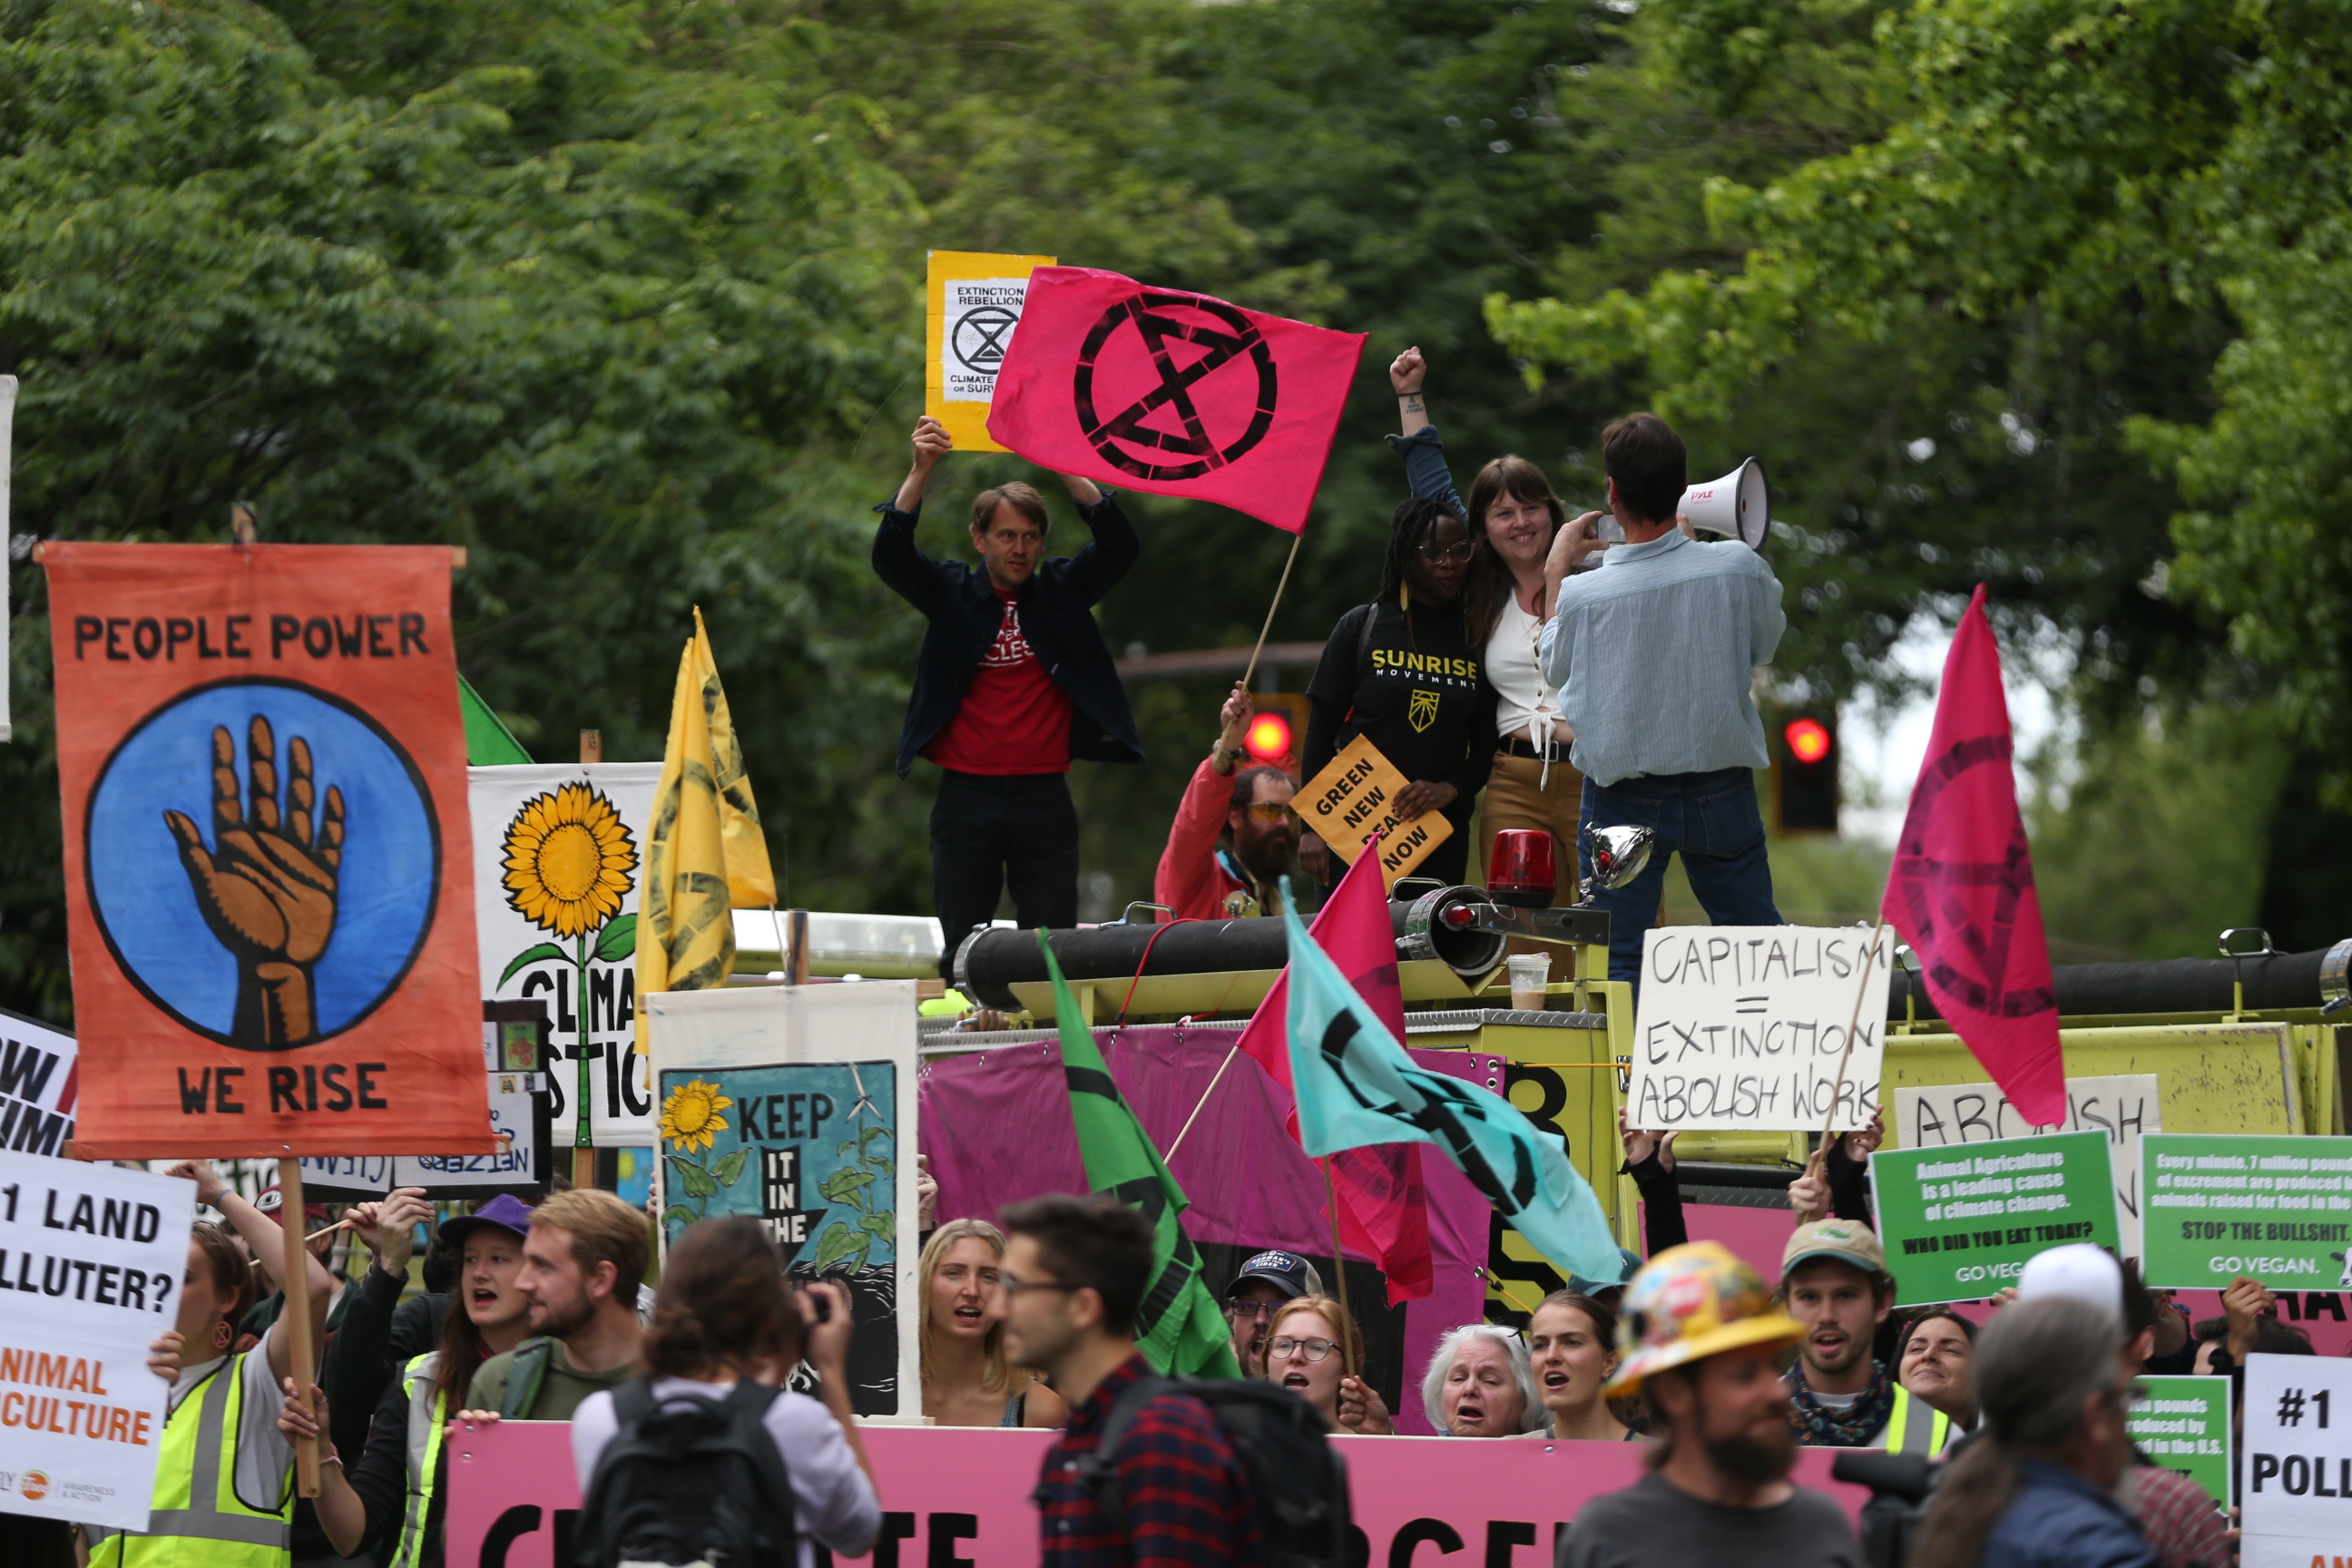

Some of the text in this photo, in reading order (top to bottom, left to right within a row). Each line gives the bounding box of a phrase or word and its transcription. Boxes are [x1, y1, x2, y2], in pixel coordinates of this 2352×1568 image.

[957, 287, 1024, 296] EXTINCTION
[958, 297, 1024, 306] REBELLION
[950, 375, 994, 384] CLIMATE
[1690, 490, 1714, 500] PYLE
[74, 612, 429, 662] PEOPLE POWER
[1371, 649, 1477, 680] SUNRISE
[1376, 669, 1475, 690] MOVEMENT
[1316, 758, 1375, 816] GREEN
[1343, 785, 1386, 829] NEW
[1361, 808, 1402, 848] DEA
[1382, 825, 1428, 872] NOW
[1652, 935, 1886, 986] CAPITALISM
[522, 968, 635, 1033] CLIMA
[1648, 1018, 1876, 1064] EXTINCTION
[0, 1037, 60, 1103] W
[177, 1063, 388, 1115] WE RISE
[1639, 1062, 1879, 1126] ABOLISH WORK
[738, 1093, 834, 1143] KEEP
[1916, 1092, 2143, 1148] ABISH
[768, 1152, 793, 1180] IT
[1916, 1151, 2064, 1181] Animal Agriculture
[2157, 1153, 2195, 1170] Every
[2196, 1154, 2249, 1171] minute,
[2249, 1154, 2259, 1170] 7
[2259, 1155, 2308, 1171] million
[769, 1183, 795, 1210] IN
[1922, 1172, 2064, 1200] is a leading cause
[2157, 1173, 2172, 1188] of
[2173, 1174, 2249, 1189] excrement
[2249, 1176, 2274, 1190] are
[2275, 1175, 2343, 1191] produced
[43, 1187, 161, 1243] LAND
[1925, 1193, 2071, 1221] of climate change.
[2151, 1192, 2352, 1210] animals raised for food in the
[760, 1214, 807, 1243] THE
[1902, 1220, 2093, 1255] WHO DID YOU EAT TODAY?
[2182, 1220, 2351, 1242] STOP THE BULLSHIT.
[1955, 1261, 2023, 1282] GO VEG
[2209, 1256, 2321, 1275] GO VEGAN.
[0, 1390, 152, 1446] CULTURE
[2153, 1397, 2208, 1415] pounds
[2277, 1387, 2330, 1429] #1
[2124, 1417, 2207, 1436] roduced by
[2154, 1438, 2170, 1454] in
[2171, 1438, 2195, 1455] the
[2197, 1438, 2224, 1455] U.S.
